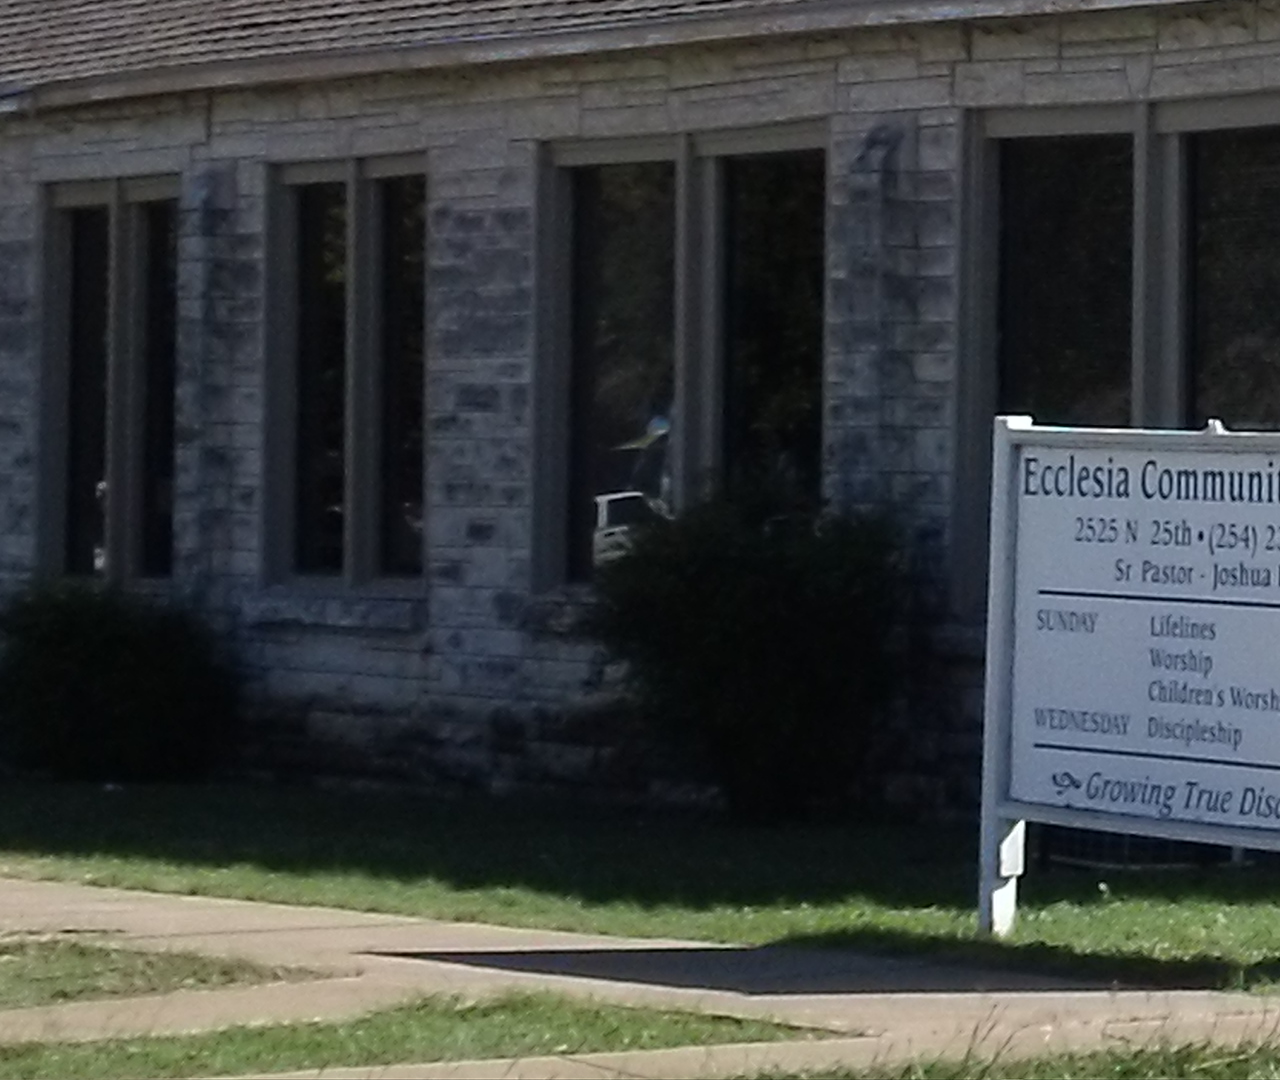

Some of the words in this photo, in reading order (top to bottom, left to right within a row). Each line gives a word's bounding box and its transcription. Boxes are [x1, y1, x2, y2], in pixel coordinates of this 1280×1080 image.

[1024, 457, 1130, 498] Ecclesia
[1075, 517, 1118, 542] 2525
[1125, 520, 1137, 543] N
[1150, 520, 1191, 546] 25th
[1209, 523, 1258, 557] (254)
[1115, 559, 1131, 581] Sr
[1142, 560, 1193, 584] Pastor
[1213, 561, 1270, 590] Joshua
[1037, 609, 1098, 633] SUNDAY
[1150, 614, 1216, 640] Lifelines
[1150, 648, 1212, 678] Worship
[1148, 680, 1225, 707] Children's
[1034, 708, 1130, 735] WEDNESDAY
[1147, 717, 1242, 750] Discipleship
[1086, 772, 1176, 816] Growing
[1184, 780, 1231, 814] True
